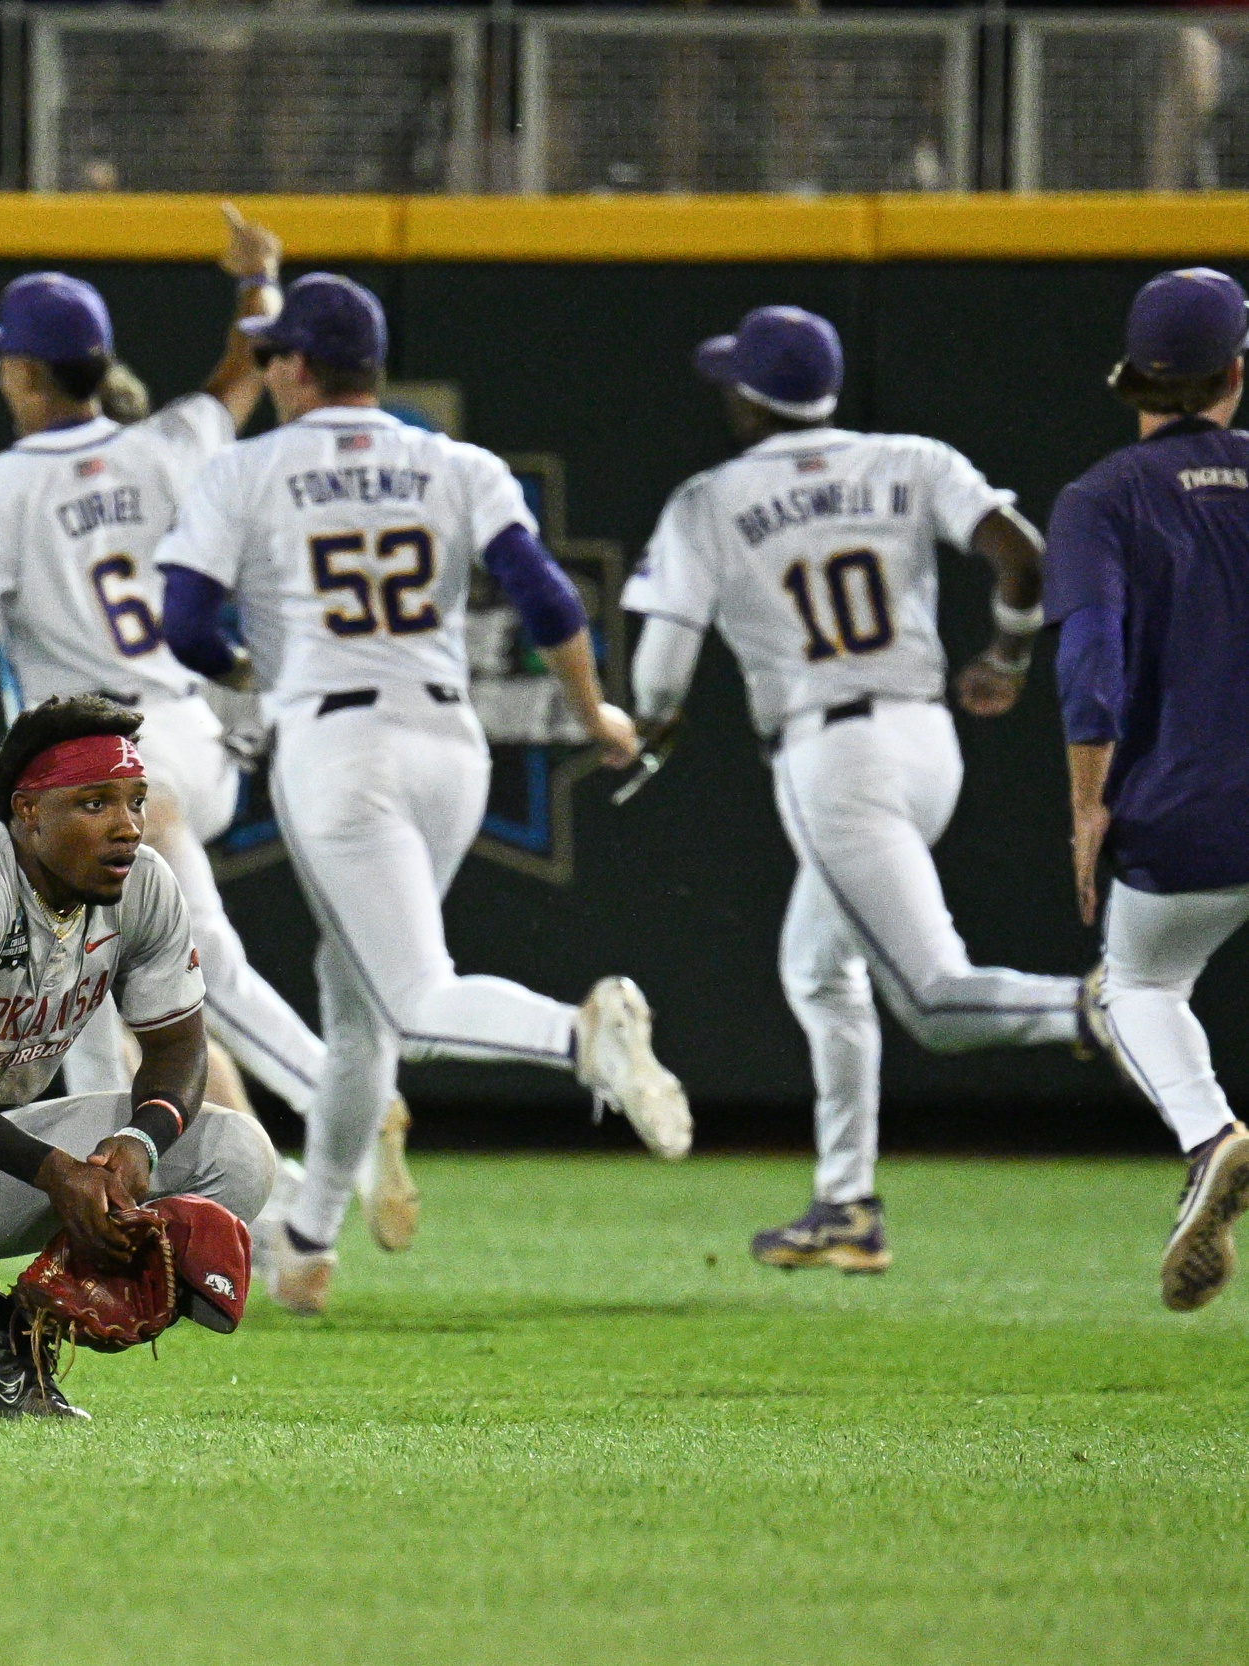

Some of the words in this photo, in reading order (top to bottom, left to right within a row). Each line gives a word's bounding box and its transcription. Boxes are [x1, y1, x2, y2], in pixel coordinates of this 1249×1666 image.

[735, 480, 874, 547] BRASWELL
[91, 552, 162, 659] 6
[308, 523, 439, 637] 52
[782, 547, 895, 662] 10
